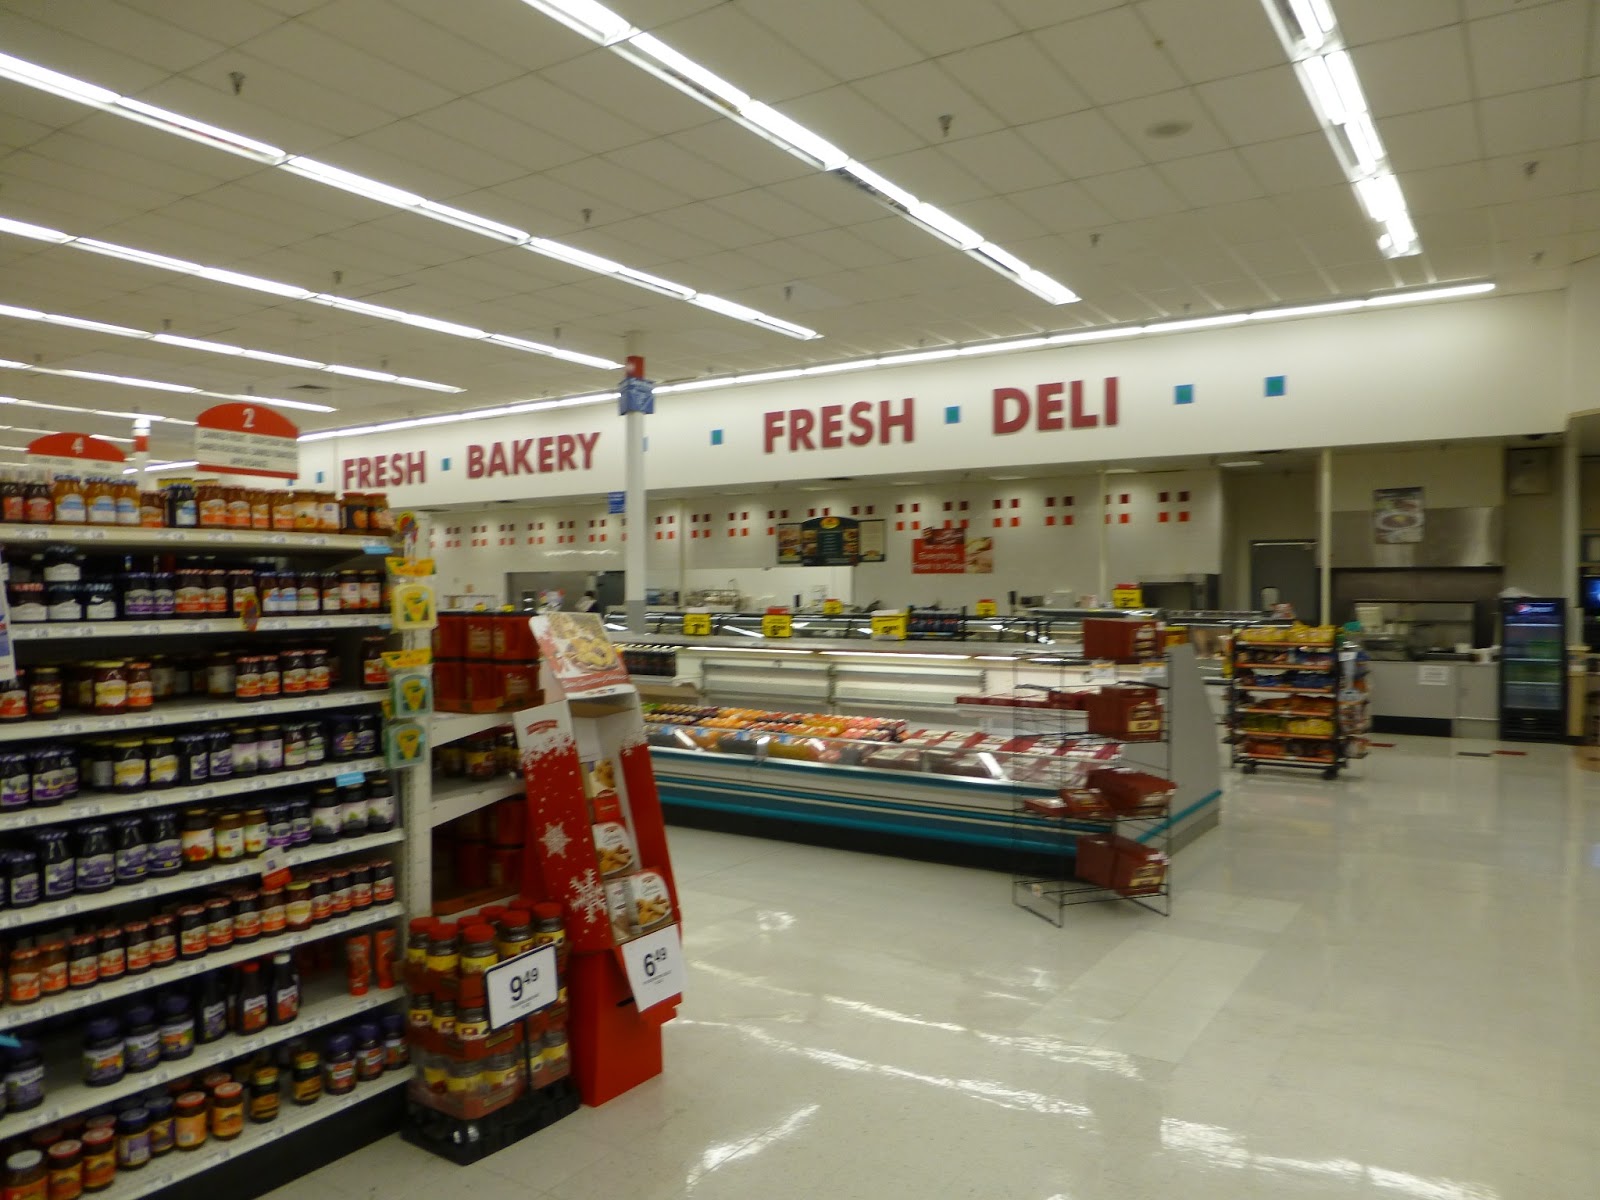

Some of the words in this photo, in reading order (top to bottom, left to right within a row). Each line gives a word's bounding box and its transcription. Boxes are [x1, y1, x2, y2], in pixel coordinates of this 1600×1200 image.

[242, 408, 256, 428] 2
[764, 398, 915, 453] FRESH
[993, 377, 1119, 435] DELI
[71, 437, 84, 455] 4
[342, 450, 426, 490] FRESH
[467, 431, 601, 479] BAKERY
